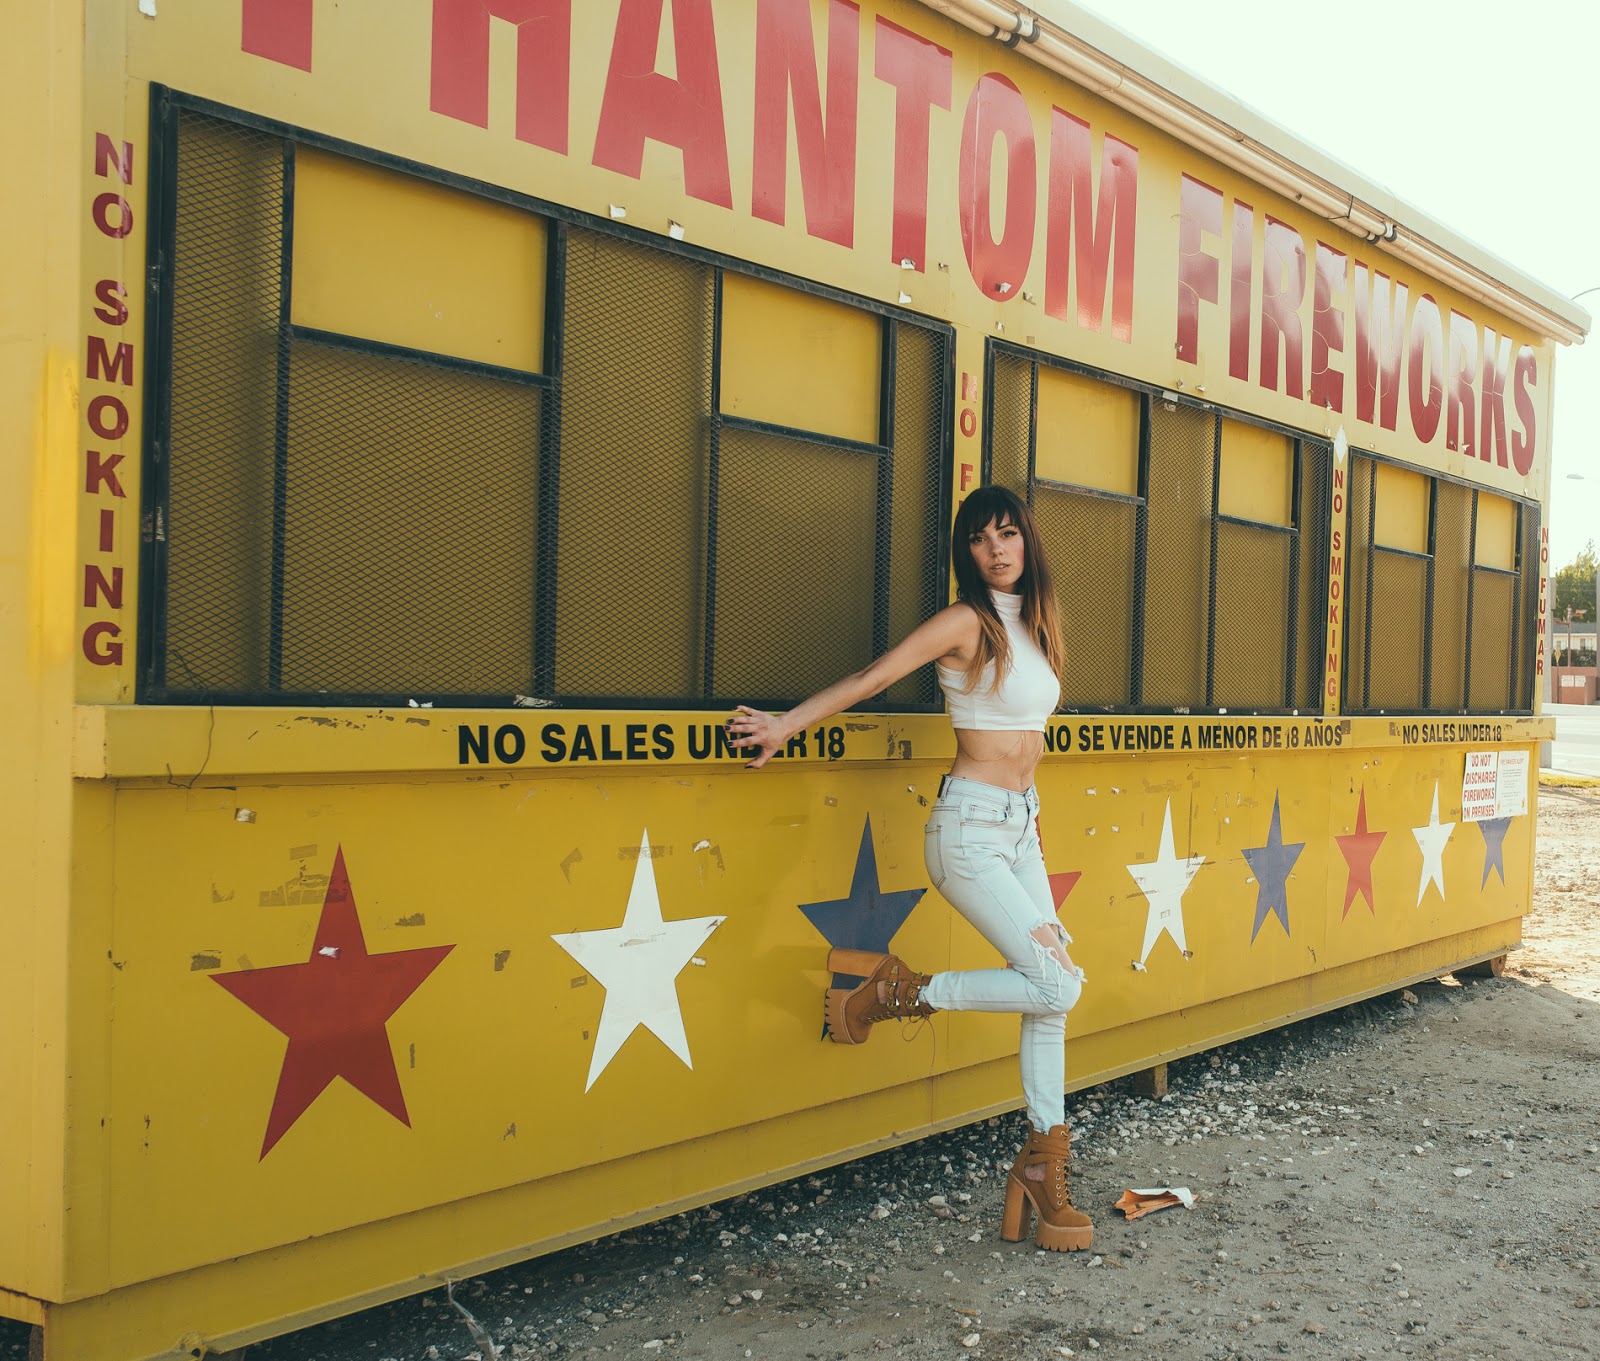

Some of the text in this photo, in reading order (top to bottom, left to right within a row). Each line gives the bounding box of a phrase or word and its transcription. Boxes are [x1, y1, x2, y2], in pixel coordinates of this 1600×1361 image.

[241, 0, 1538, 477] ANTOM FIREWORKS
[81, 131, 135, 667] NO SMOKING
[959, 371, 978, 438] NO
[1327, 468, 1344, 698] NO SMOKING
[1536, 527, 1549, 676] NO FUMAR
[457, 723, 846, 765] NO SALES UNR 18
[1043, 724, 1072, 753] NO
[1078, 724, 1105, 752] SE
[1109, 724, 1175, 751] VENDE
[1180, 724, 1193, 750] A
[1198, 724, 1258, 750] MENOR
[1262, 725, 1282, 748] DE
[1284, 725, 1299, 749] 18
[1402, 723, 1502, 744] NO SALES UNDER 18
[1465, 771, 1496, 785] DISCHARGE
[1471, 754, 1479, 767] DO
[1480, 754, 1491, 767] NOT
[1464, 787, 1495, 802] FIREWORKS
[1472, 804, 1495, 818] PREMISES
